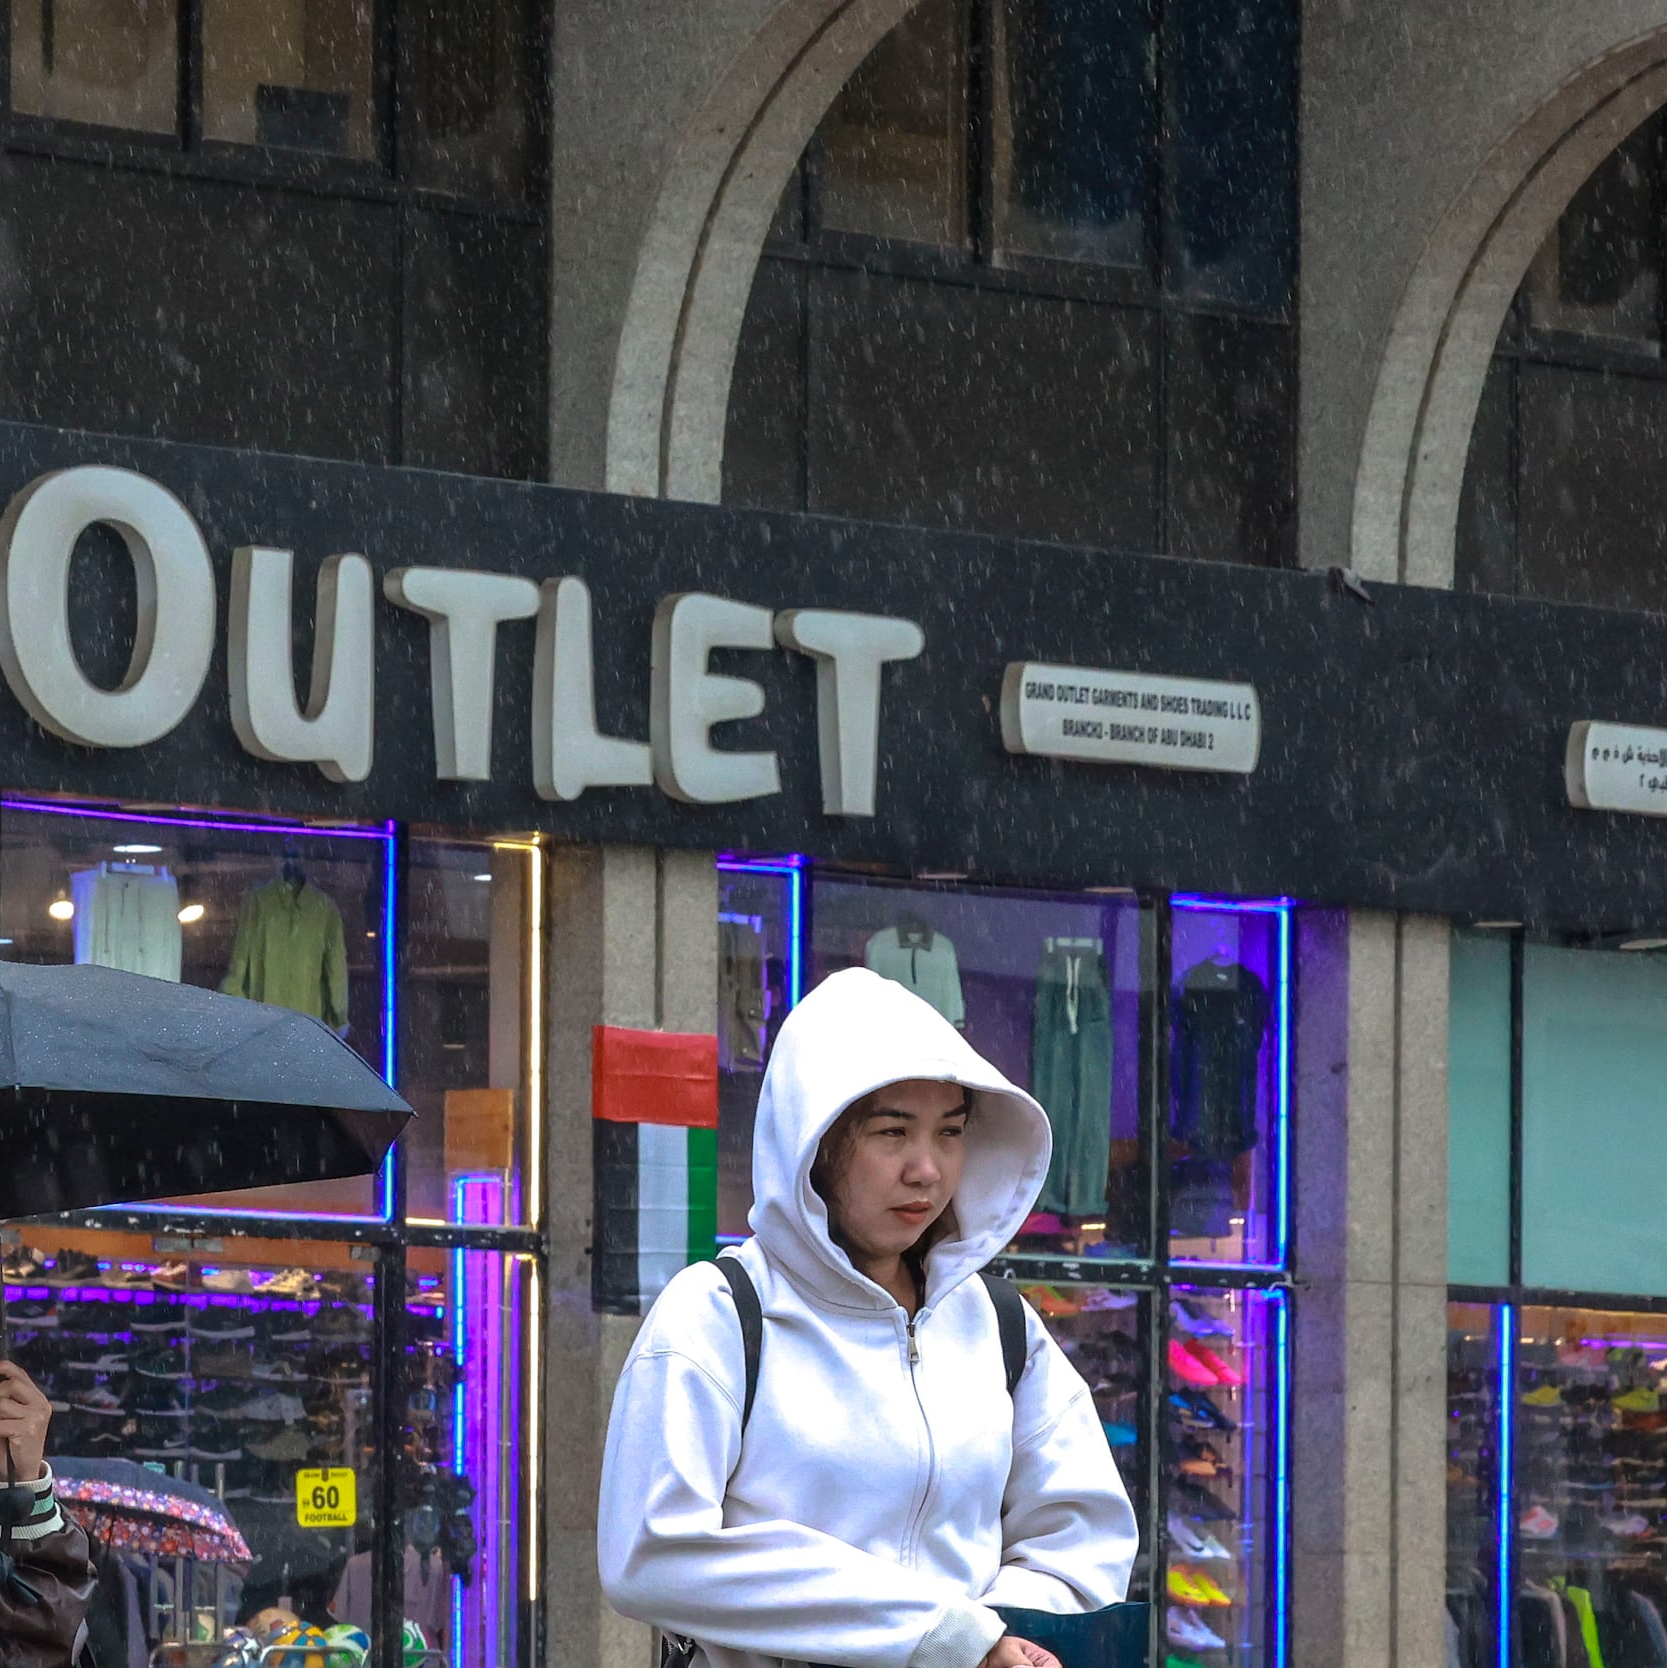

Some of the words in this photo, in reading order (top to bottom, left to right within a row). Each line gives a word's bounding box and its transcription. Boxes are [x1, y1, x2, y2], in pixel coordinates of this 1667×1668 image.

[1024, 681, 1056, 701] GRAND
[1057, 684, 1090, 704] OUTLET
[1091, 687, 1139, 710] GARMENTS
[1140, 692, 1159, 712] AND
[1160, 694, 1190, 716] SHOES
[1190, 697, 1229, 720] TRADING
[1110, 722, 1145, 744] BRANCH
[1147, 725, 1160, 745] OF
[1160, 727, 1179, 748] ABU
[1179, 728, 1207, 750] DHABI
[312, 1486, 339, 1509] 60
[304, 1512, 348, 1523] FOOTBALL
